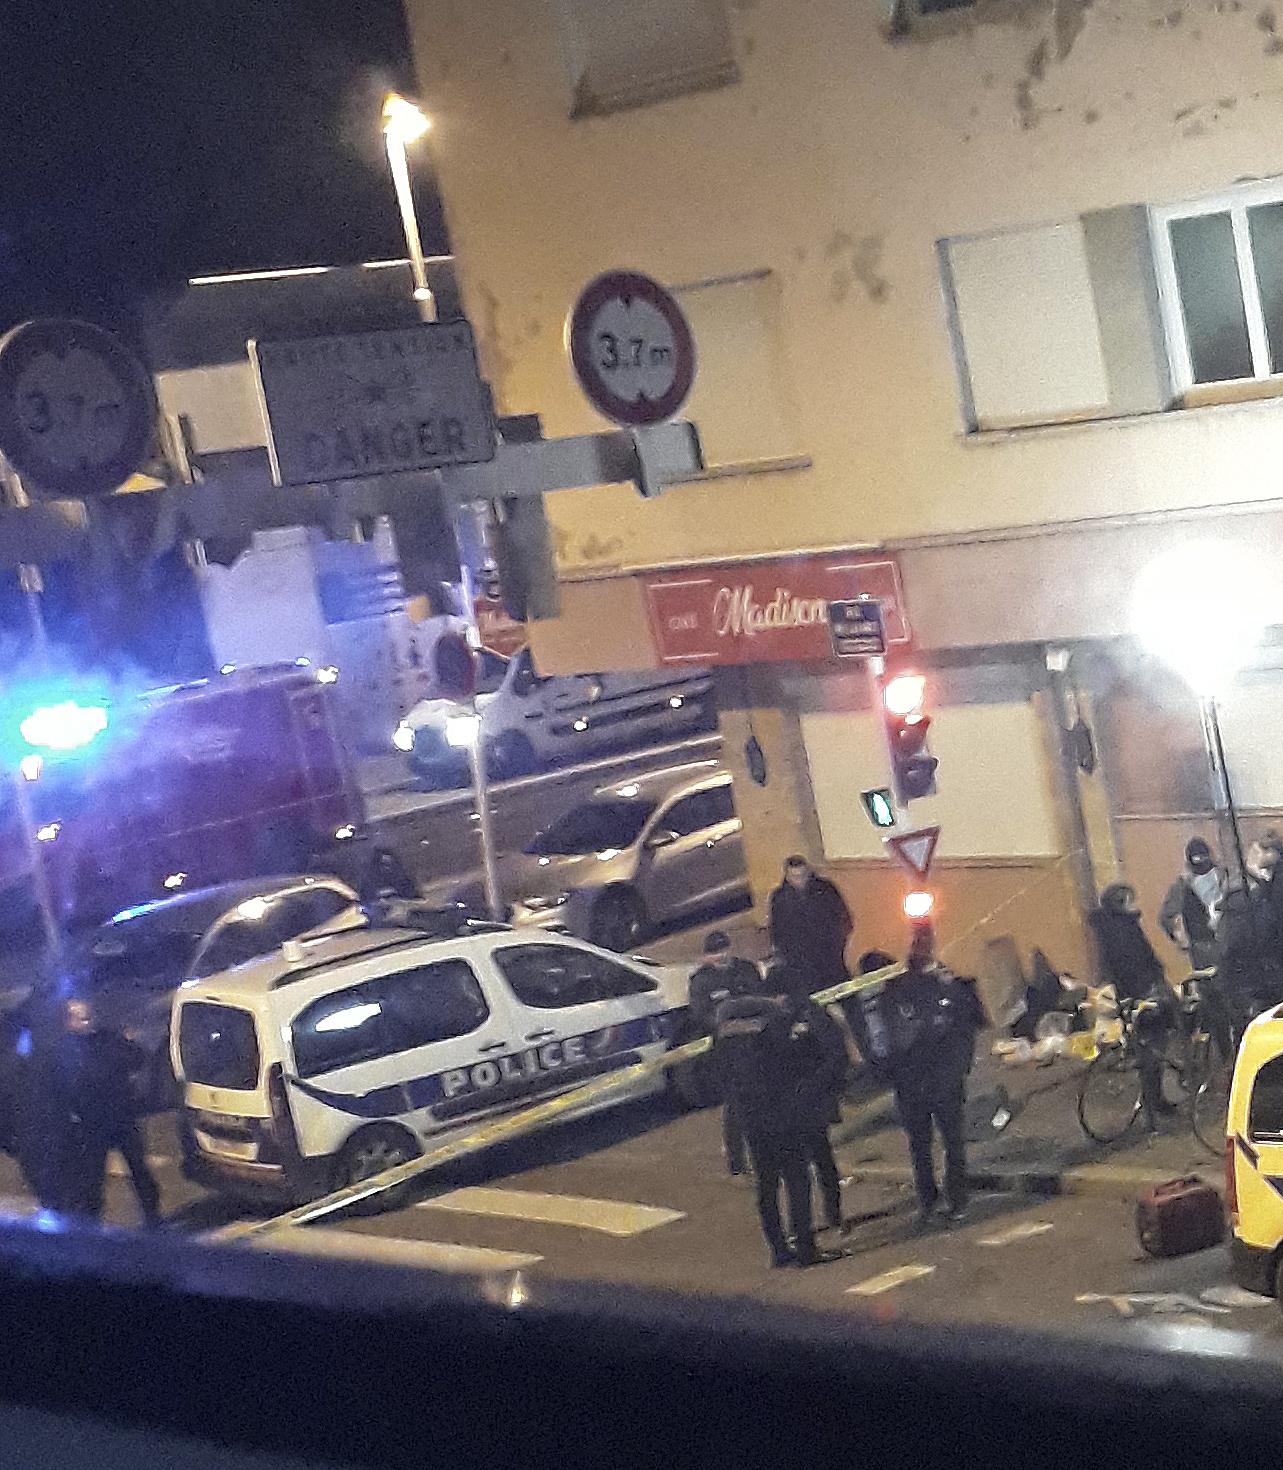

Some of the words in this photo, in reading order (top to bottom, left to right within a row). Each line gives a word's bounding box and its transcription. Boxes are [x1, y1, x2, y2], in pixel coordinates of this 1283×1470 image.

[303, 417, 467, 471] DANGER
[713, 584, 828, 636] Madison
[441, 1038, 587, 1098] POLICE
